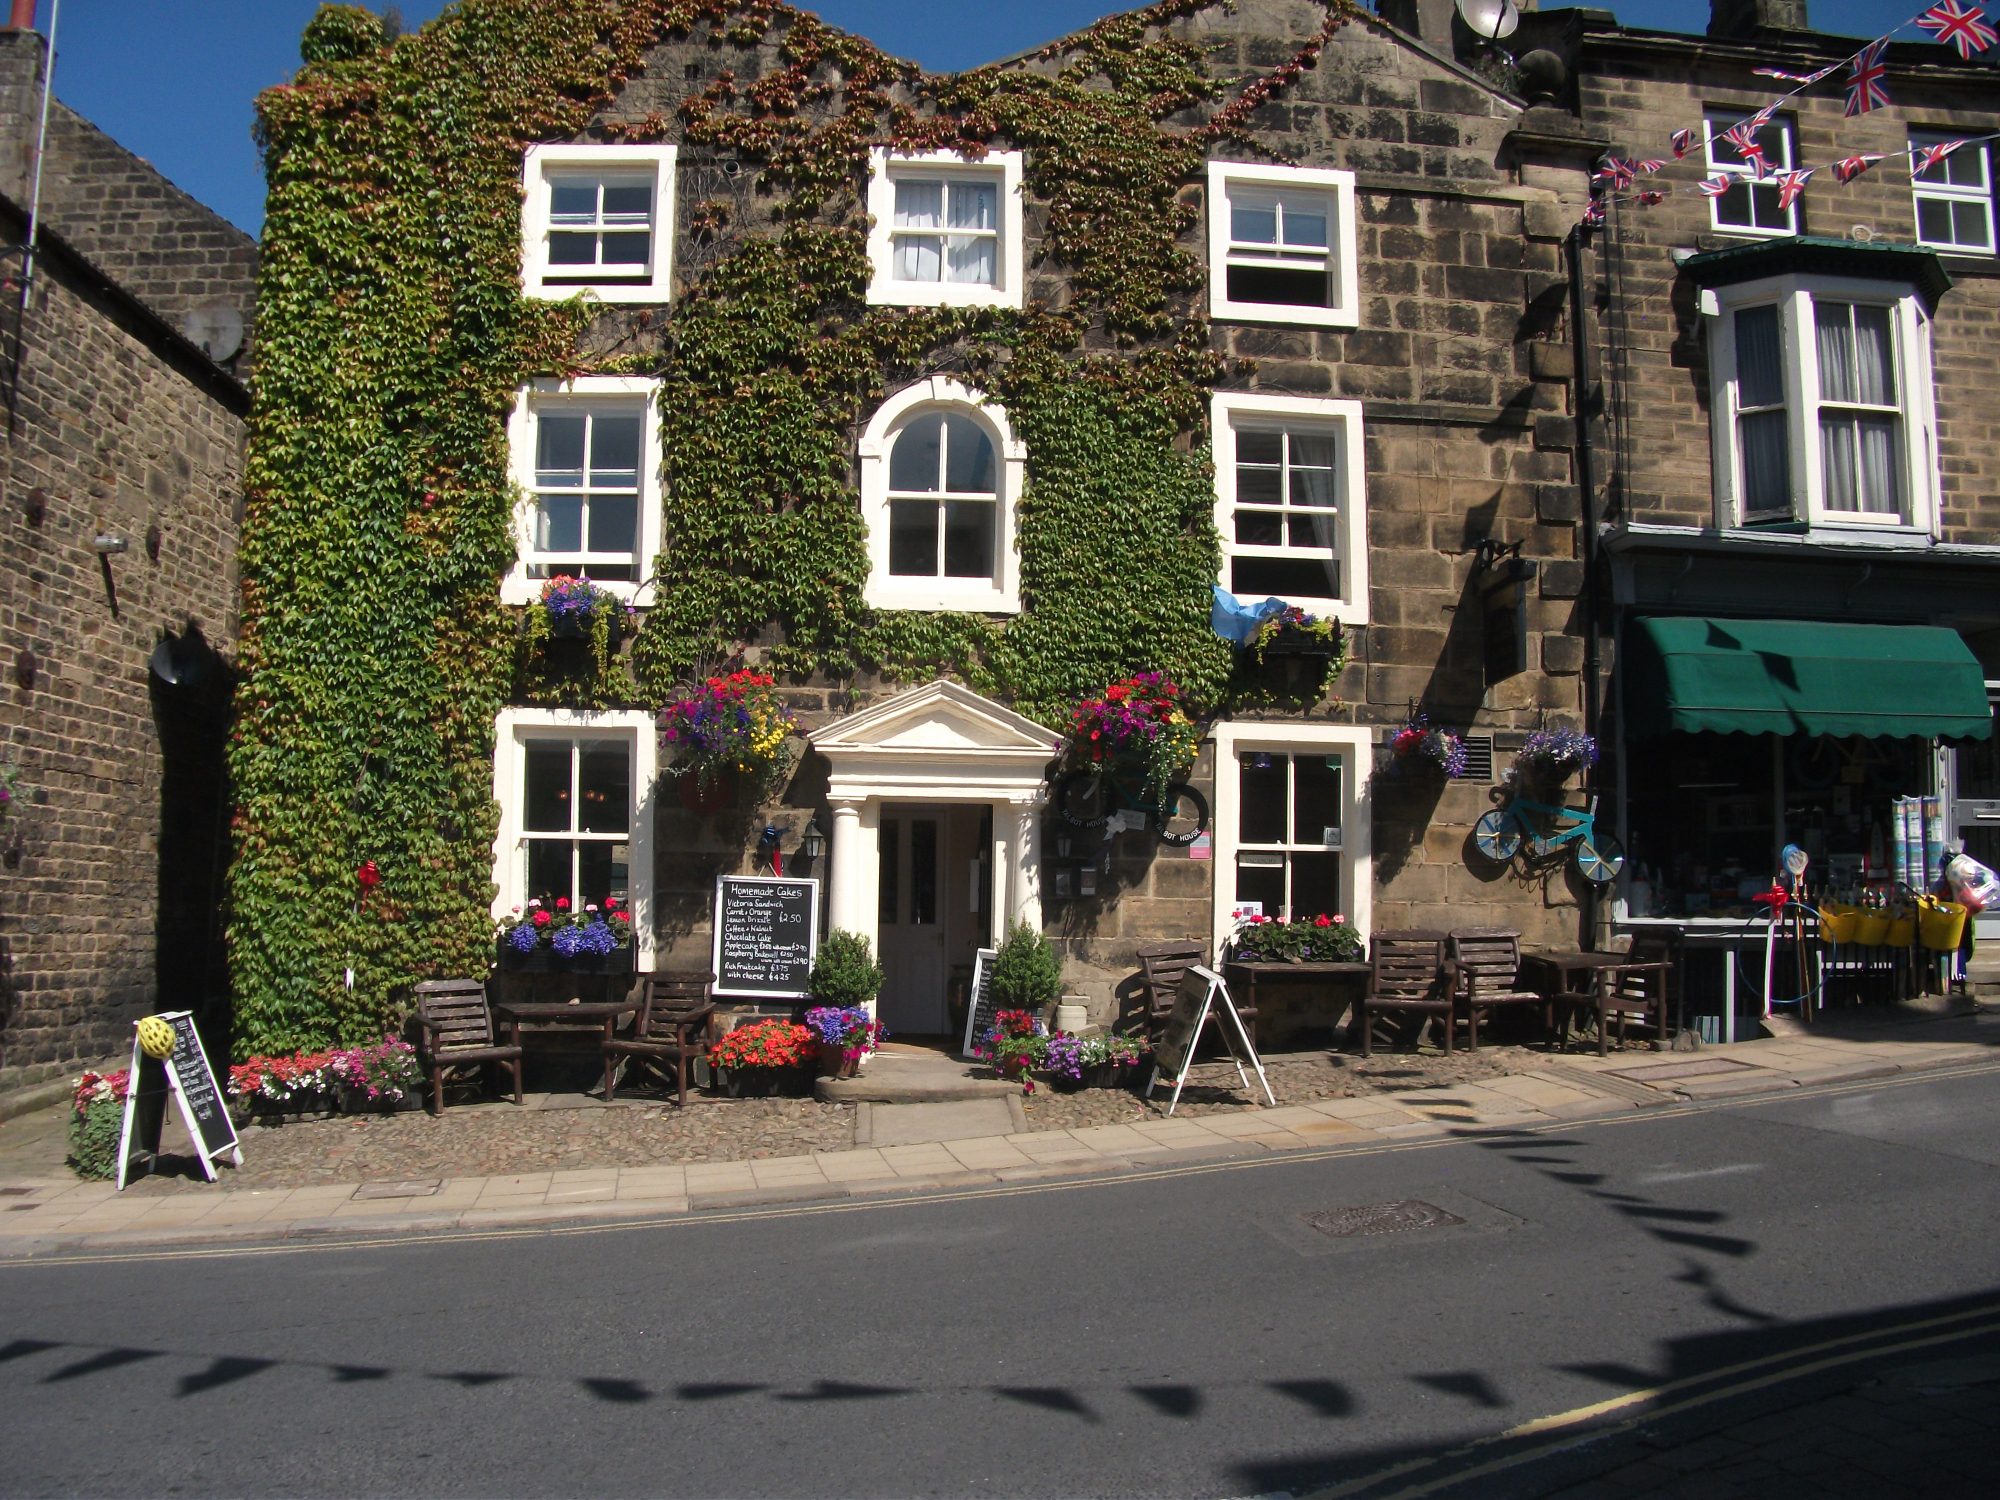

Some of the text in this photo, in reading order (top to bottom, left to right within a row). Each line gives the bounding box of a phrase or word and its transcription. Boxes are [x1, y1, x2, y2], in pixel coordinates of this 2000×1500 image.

[1179, 827, 1201, 842] HOUSE
[731, 883, 802, 897] Homemade Cakes
[727, 898, 784, 908] Victoria Sandwich
[749, 908, 772, 918] Orange
[748, 916, 771, 924] Drizzle
[726, 924, 746, 933] Coffee
[751, 924, 773, 932] Walnut
[724, 932, 772, 942] Chocolate Cake
[724, 950, 754, 960] Raspberry
[724, 962, 737, 970] Rich
[742, 972, 764, 980] cheese
